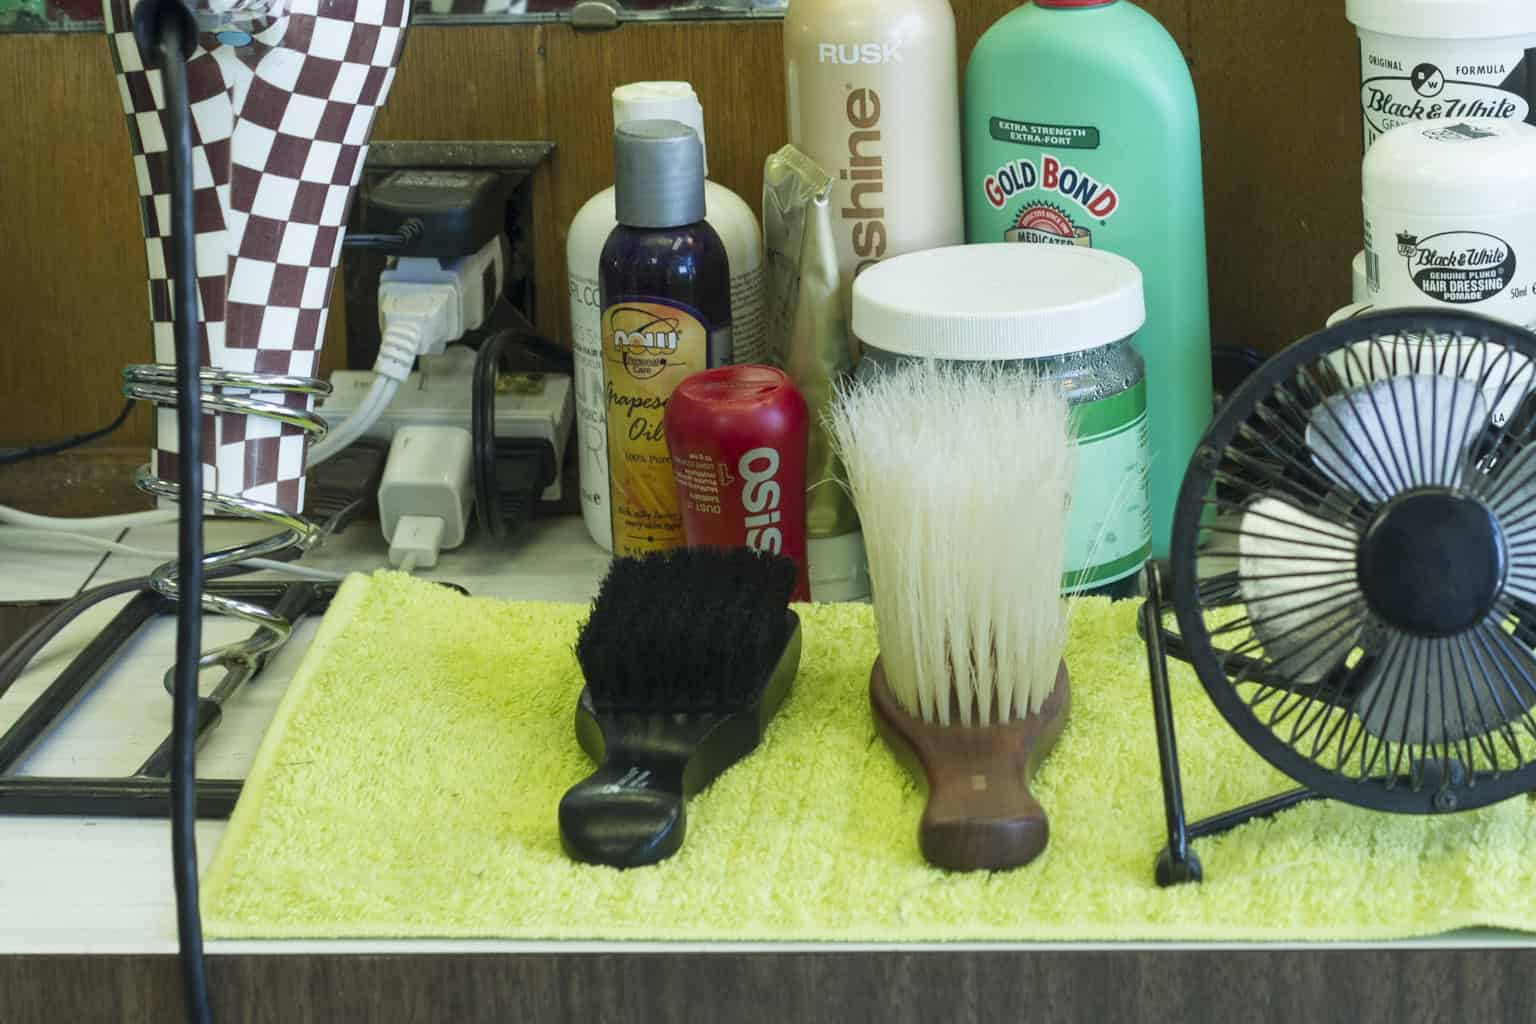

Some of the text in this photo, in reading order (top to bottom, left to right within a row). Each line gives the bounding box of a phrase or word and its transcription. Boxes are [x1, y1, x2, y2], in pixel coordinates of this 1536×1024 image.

[818, 43, 904, 64] RUSK
[1368, 55, 1403, 71] ORIGINAL
[1456, 64, 1505, 76] FORMULA
[1367, 87, 1426, 119] Black
[999, 121, 1086, 137] EXTRA STRENGTH
[1010, 132, 1071, 145] EXTRA-FORT
[985, 157, 1117, 217] GOLD BOND
[1422, 278, 1503, 292] HAIR DRESSING
[1443, 292, 1482, 300] POMADE
